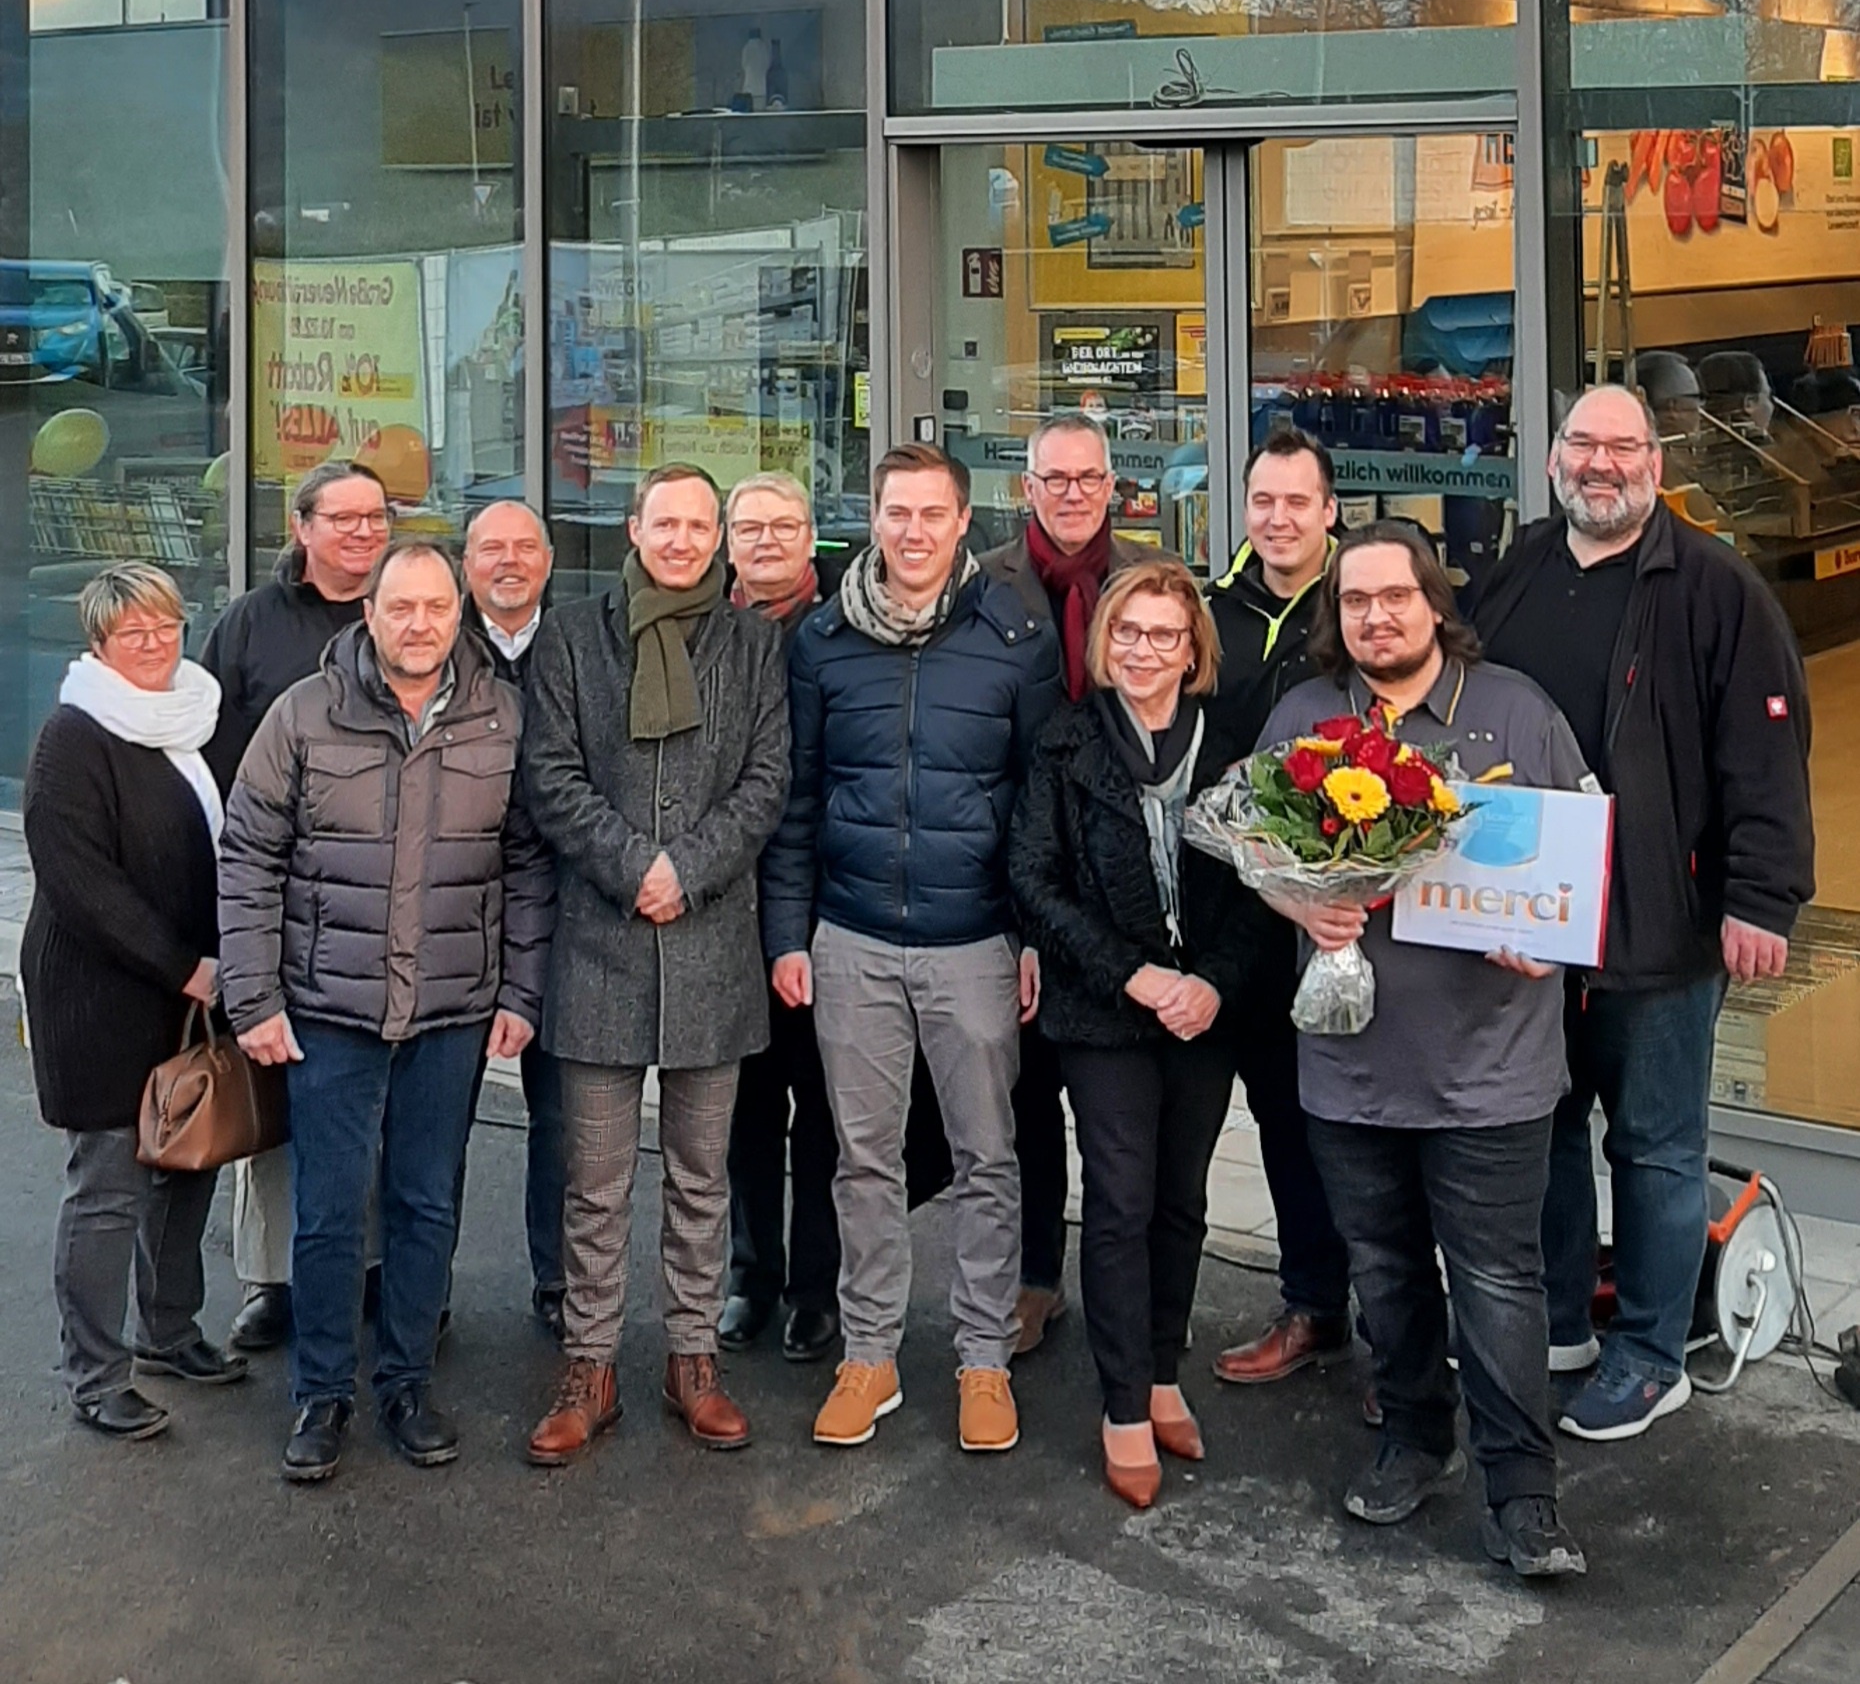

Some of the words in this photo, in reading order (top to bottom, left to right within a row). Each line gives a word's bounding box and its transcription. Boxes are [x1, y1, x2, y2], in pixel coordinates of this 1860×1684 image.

[1333, 460, 1380, 482] zlich
[1386, 462, 1511, 489] willkommen
[1419, 880, 1574, 923] merci
